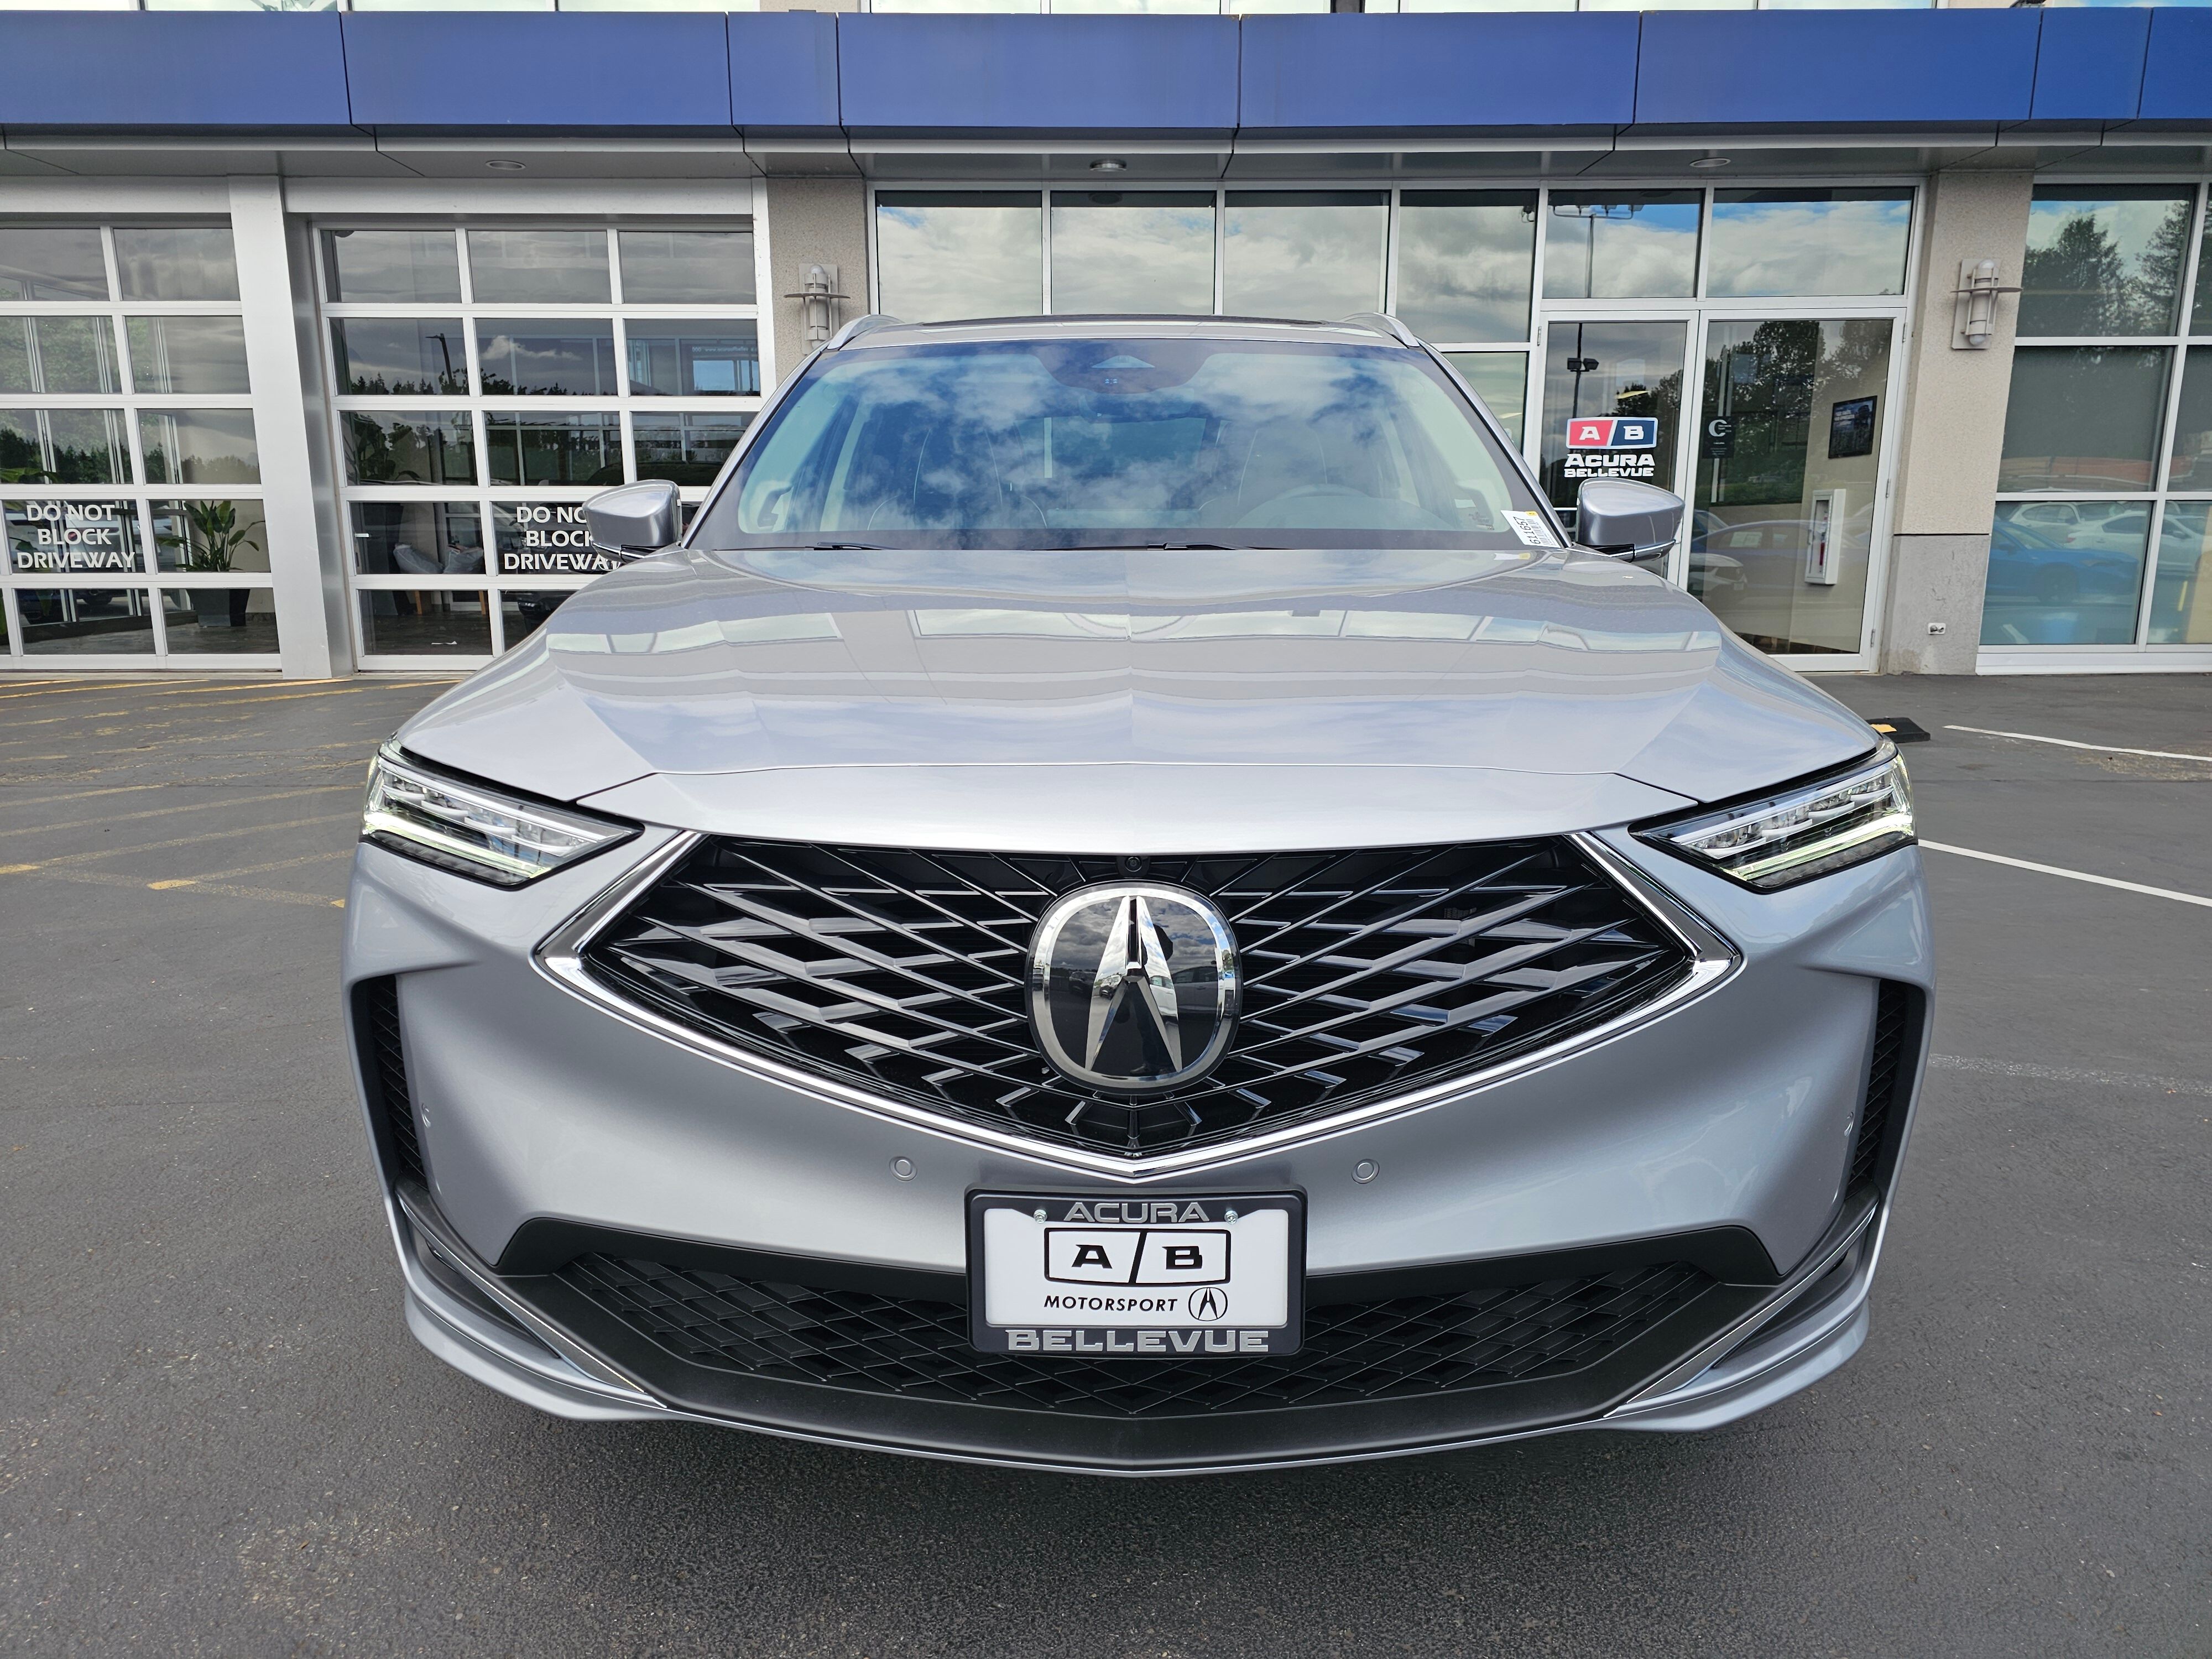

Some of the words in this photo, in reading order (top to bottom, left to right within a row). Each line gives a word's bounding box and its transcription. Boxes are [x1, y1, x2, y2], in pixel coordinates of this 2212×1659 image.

[1564, 453, 1655, 467] ACURA
[1564, 468, 1654, 478] BELLEVUE
[27, 504, 61, 521] DO
[67, 504, 115, 521] NOT
[517, 507, 551, 523] DO
[557, 507, 587, 523] NO
[38, 528, 112, 545] BLOCK
[1513, 517, 1541, 544] 611657
[17, 552, 135, 568] DRIVEWAY
[1063, 1202, 1210, 1224] ACURA
[1044, 1295, 1178, 1312] MOTORSPORT
[1005, 1329, 1269, 1353] BELLEVUE
